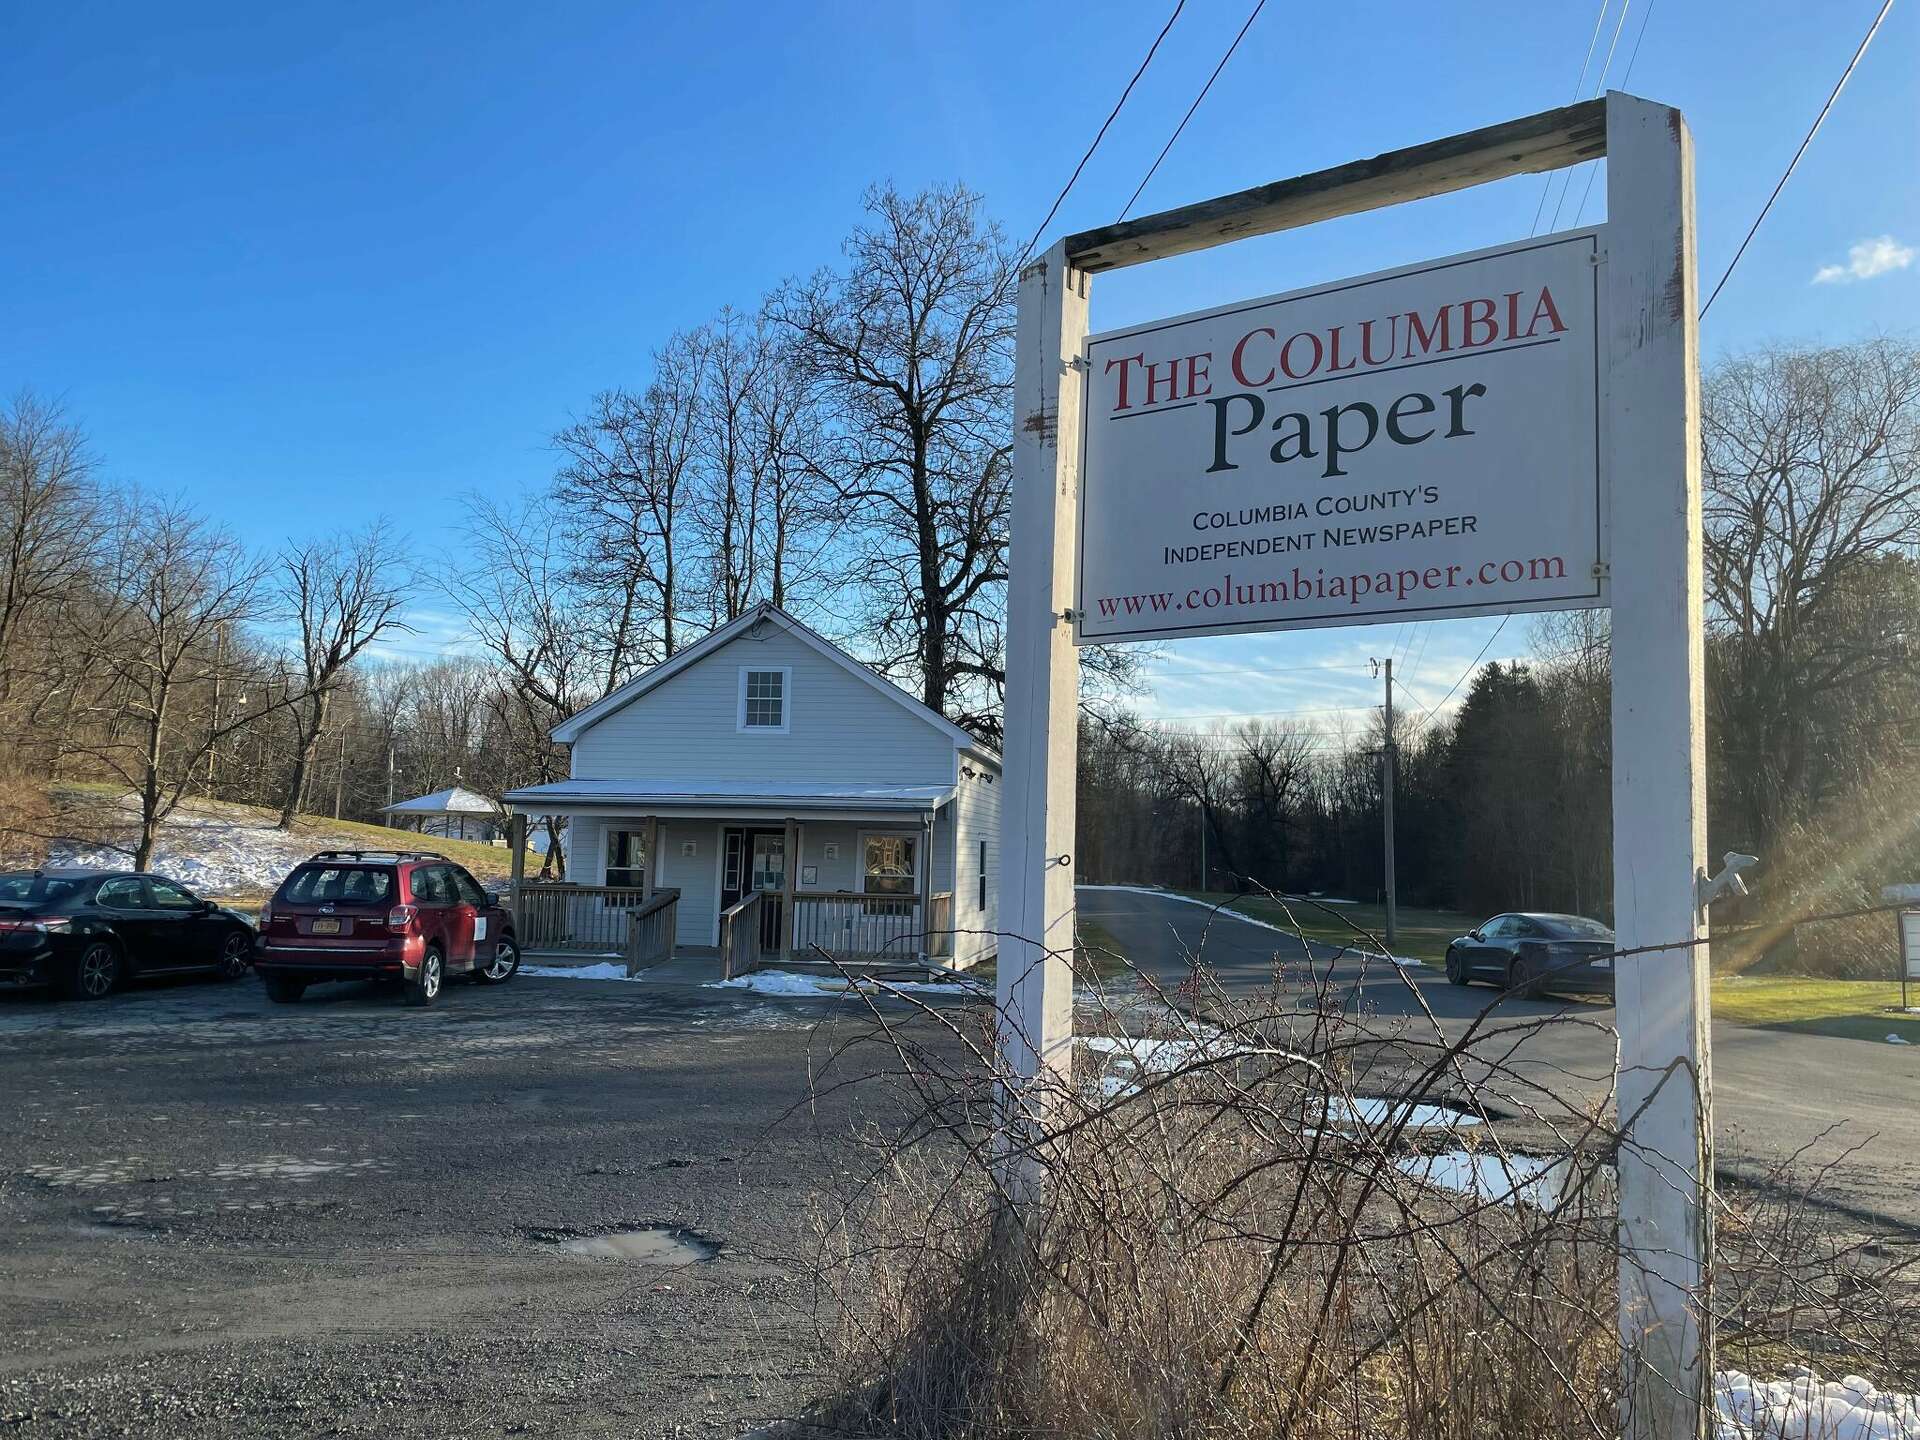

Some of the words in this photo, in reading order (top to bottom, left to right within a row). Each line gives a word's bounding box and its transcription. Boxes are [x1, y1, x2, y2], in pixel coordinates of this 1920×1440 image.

[1104, 351, 1213, 412] THE
[1231, 285, 1570, 389] COLUMBIA
[1204, 382, 1487, 479] Paper
[1164, 532, 1317, 565] INDEPENDENT
[1323, 515, 1478, 549] NEWSPAPER
[1193, 502, 1309, 531] COLUMBIA
[1315, 485, 1439, 517] COUNTY'S
[1097, 553, 1568, 617] www.columbiapaper.com
